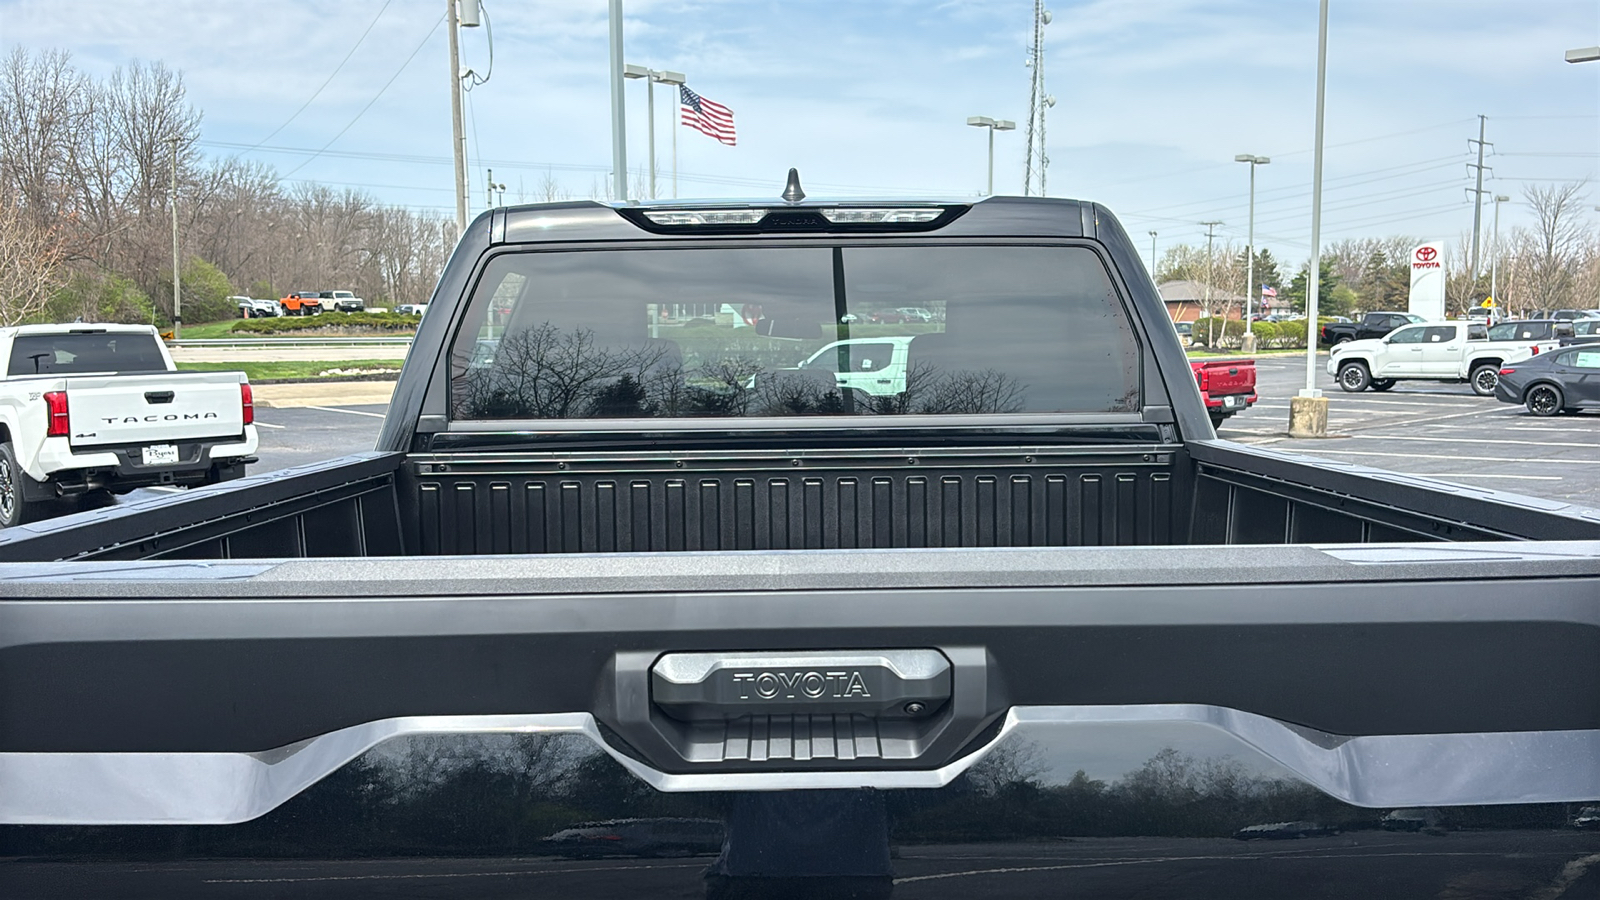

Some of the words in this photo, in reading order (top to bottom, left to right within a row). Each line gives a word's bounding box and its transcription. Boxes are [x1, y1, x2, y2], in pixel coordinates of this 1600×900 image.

[1412, 261, 1440, 269] TOYOTA
[101, 412, 217, 424] TACOMA
[733, 671, 871, 699] TOYOTA
